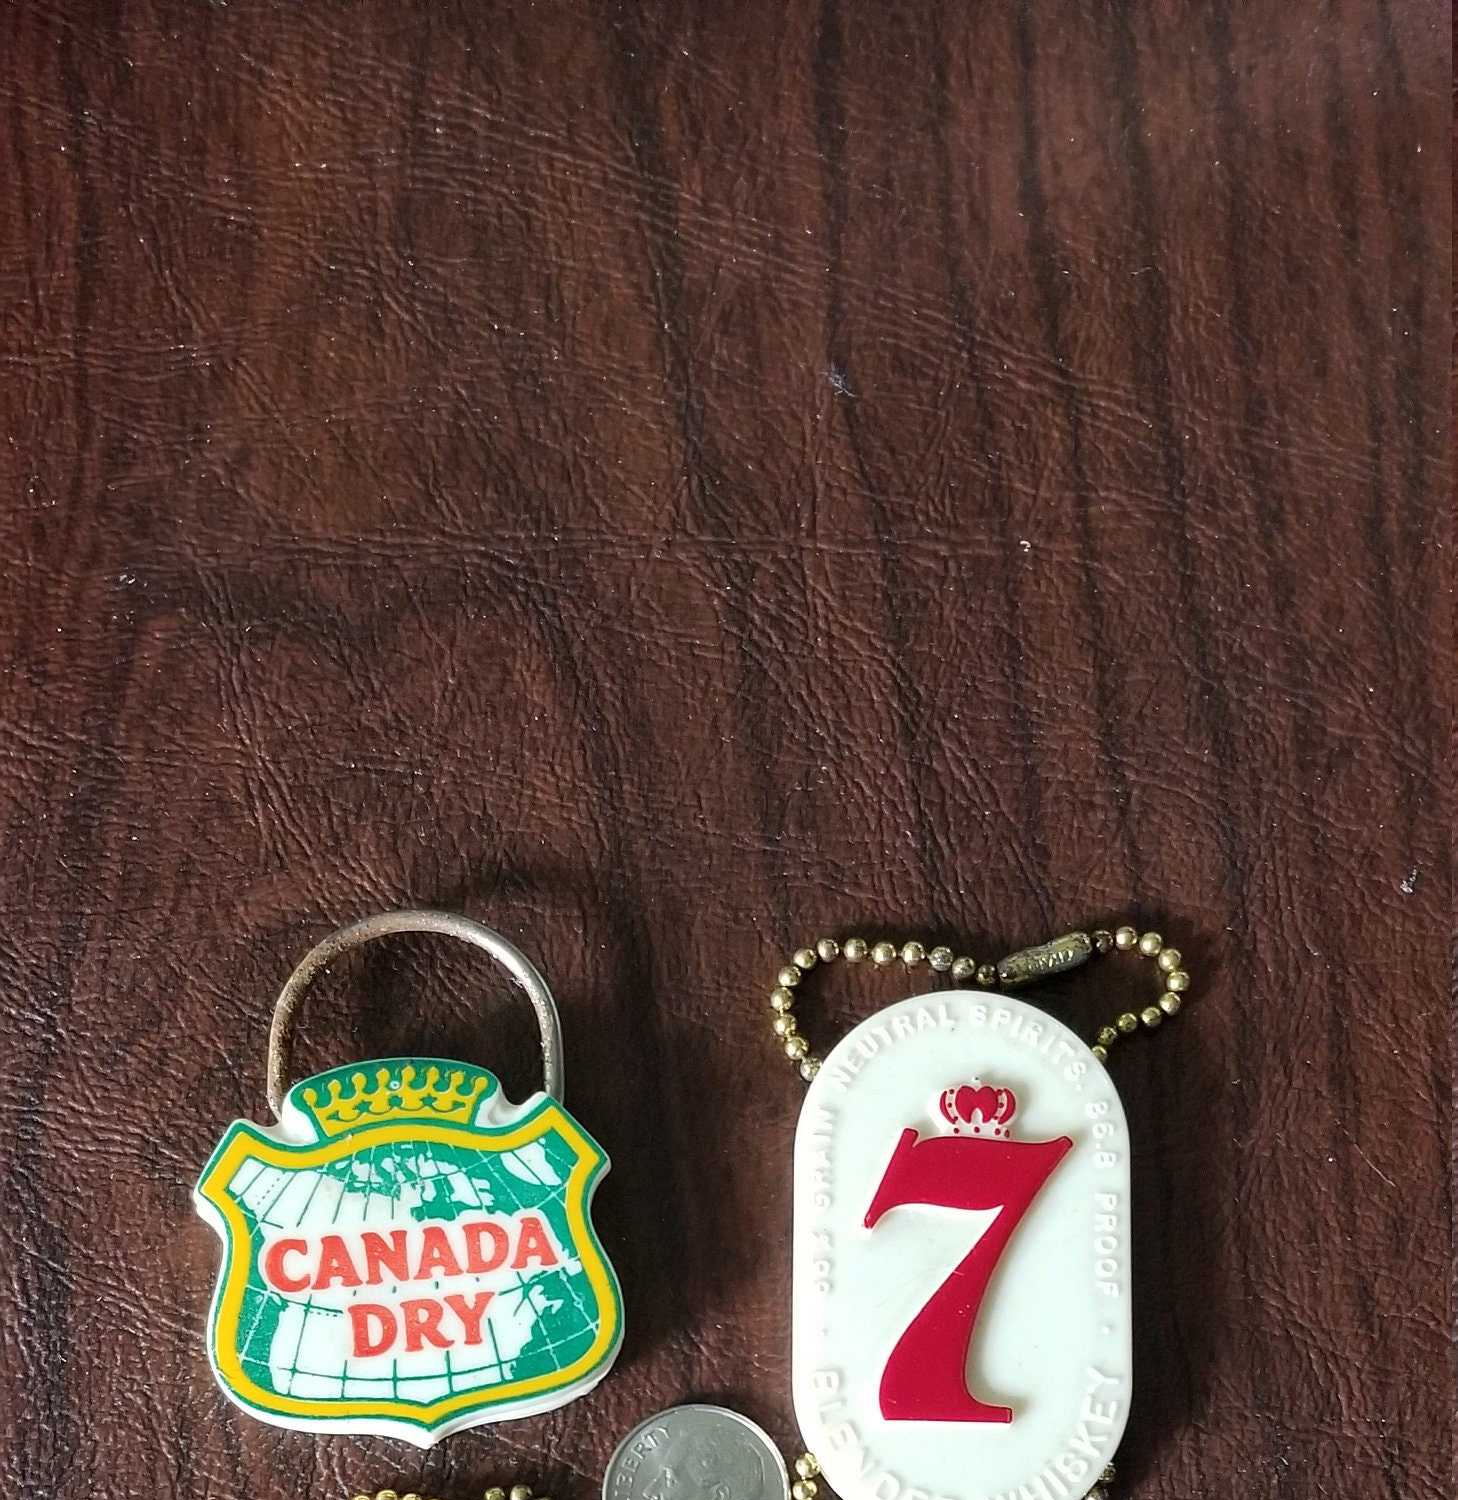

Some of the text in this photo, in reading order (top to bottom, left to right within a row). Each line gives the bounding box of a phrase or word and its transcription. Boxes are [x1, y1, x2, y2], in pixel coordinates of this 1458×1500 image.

[826, 1003, 957, 1093] NEUTRAL
[1085, 1100, 1118, 1170] 86.8
[263, 1216, 560, 1294] CANADA
[863, 1127, 1074, 1423] 7
[1092, 1192, 1120, 1299] PROOF
[346, 1291, 496, 1359] DRY
